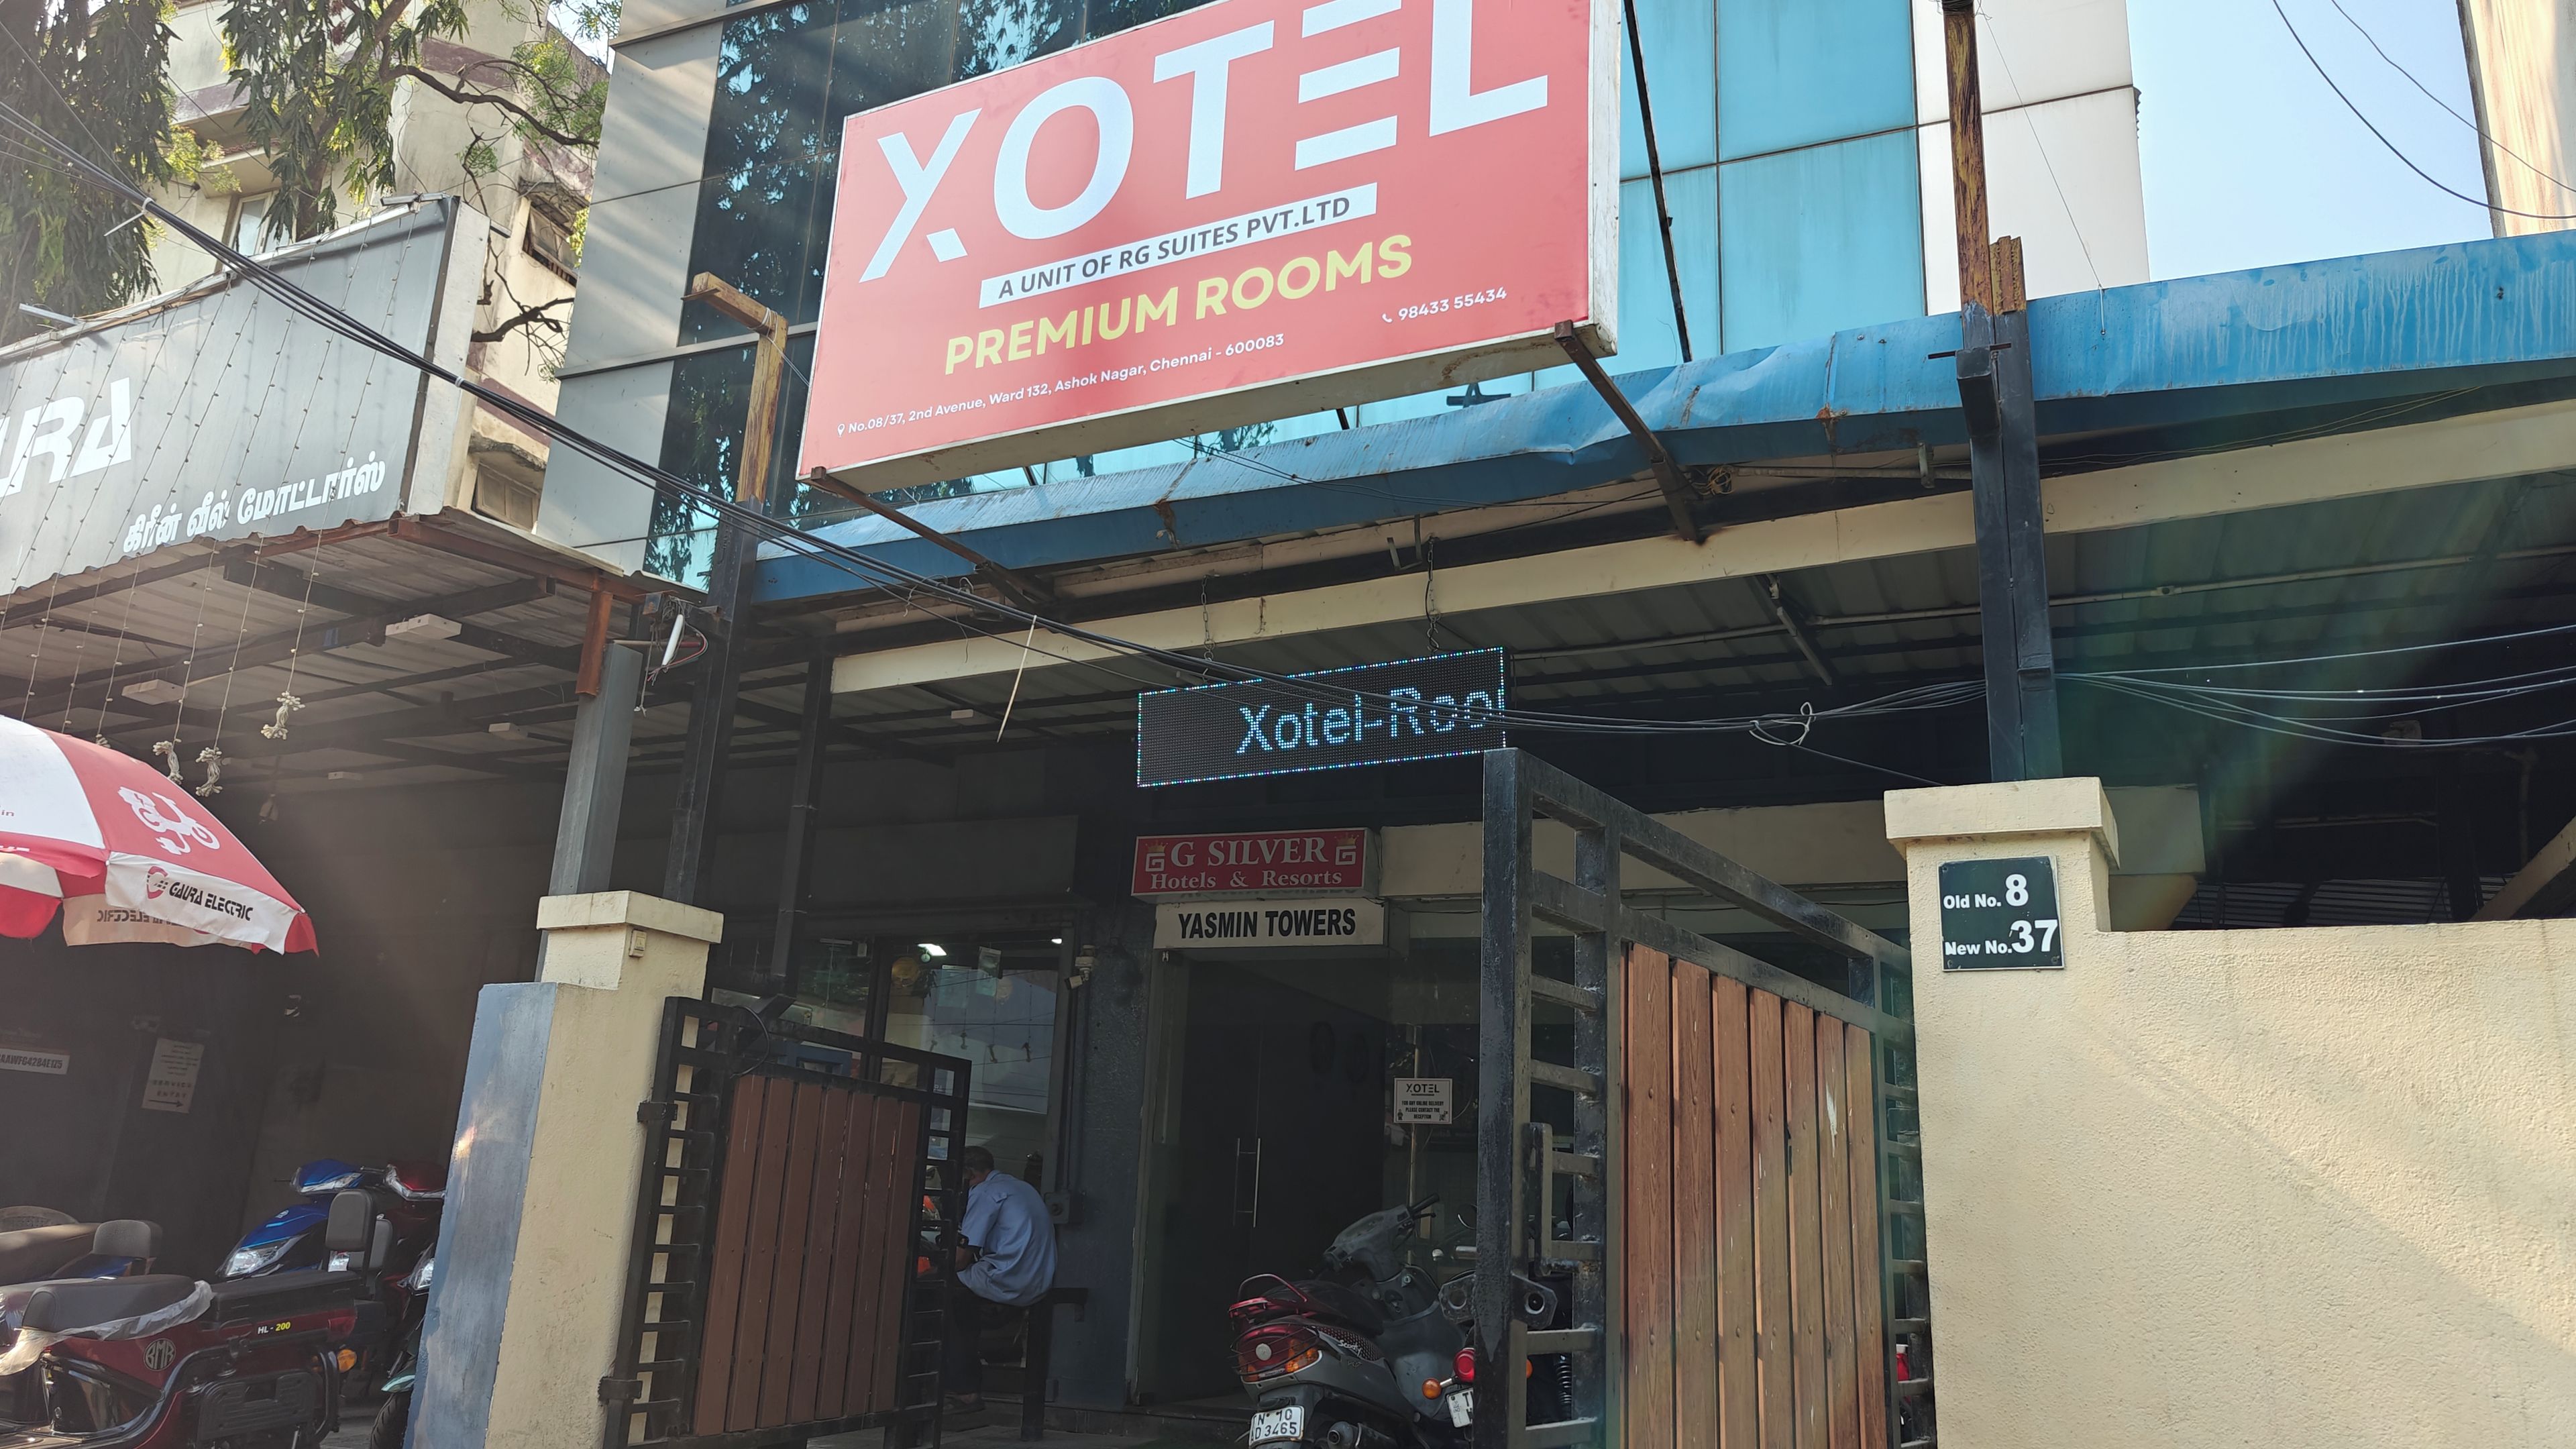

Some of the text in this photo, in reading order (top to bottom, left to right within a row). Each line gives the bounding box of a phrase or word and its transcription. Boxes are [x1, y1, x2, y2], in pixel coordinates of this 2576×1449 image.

[859, 0, 1548, 282] XOTEL
[998, 197, 1350, 299] A UNIT OF RG SUITES PVT.LTD
[945, 235, 1412, 376] PREMIUM ROOMS
[1398, 286, 1507, 321] 98433 55434
[848, 412, 906, 433] No.08/37,
[908, 407, 933, 422] 2nd
[934, 398, 987, 417] Avenue,
[989, 388, 1024, 405] Ward
[1026, 383, 1053, 398] 132,
[1055, 372, 1097, 392] Ashok
[1100, 364, 1148, 384] Nagar,
[1150, 347, 1213, 372] Chennai
[1225, 333, 1285, 356] 600083
[237, 450, 386, 525] மோட்டார்ஸ்
[1236, 686, 1505, 754] Xotel-Roo
[1171, 841, 1196, 867] G
[1207, 837, 1330, 867] SILVER
[1150, 869, 1342, 890] Hotels & Resorts
[1943, 873, 2029, 909] Old No. 8
[169, 881, 204, 906] GAURA
[204, 893, 254, 922] ELECTRIC
[1178, 908, 1356, 939] YASMIN TOWERS
[1945, 918, 2059, 957] New No. 37
[1406, 1083, 1440, 1093] XOTEL
[258, 1326, 269, 1334] HL
[275, 1322, 291, 1332] 200
[1264, 1421, 1297, 1437] 3465
[1278, 1408, 1293, 1421] 10
